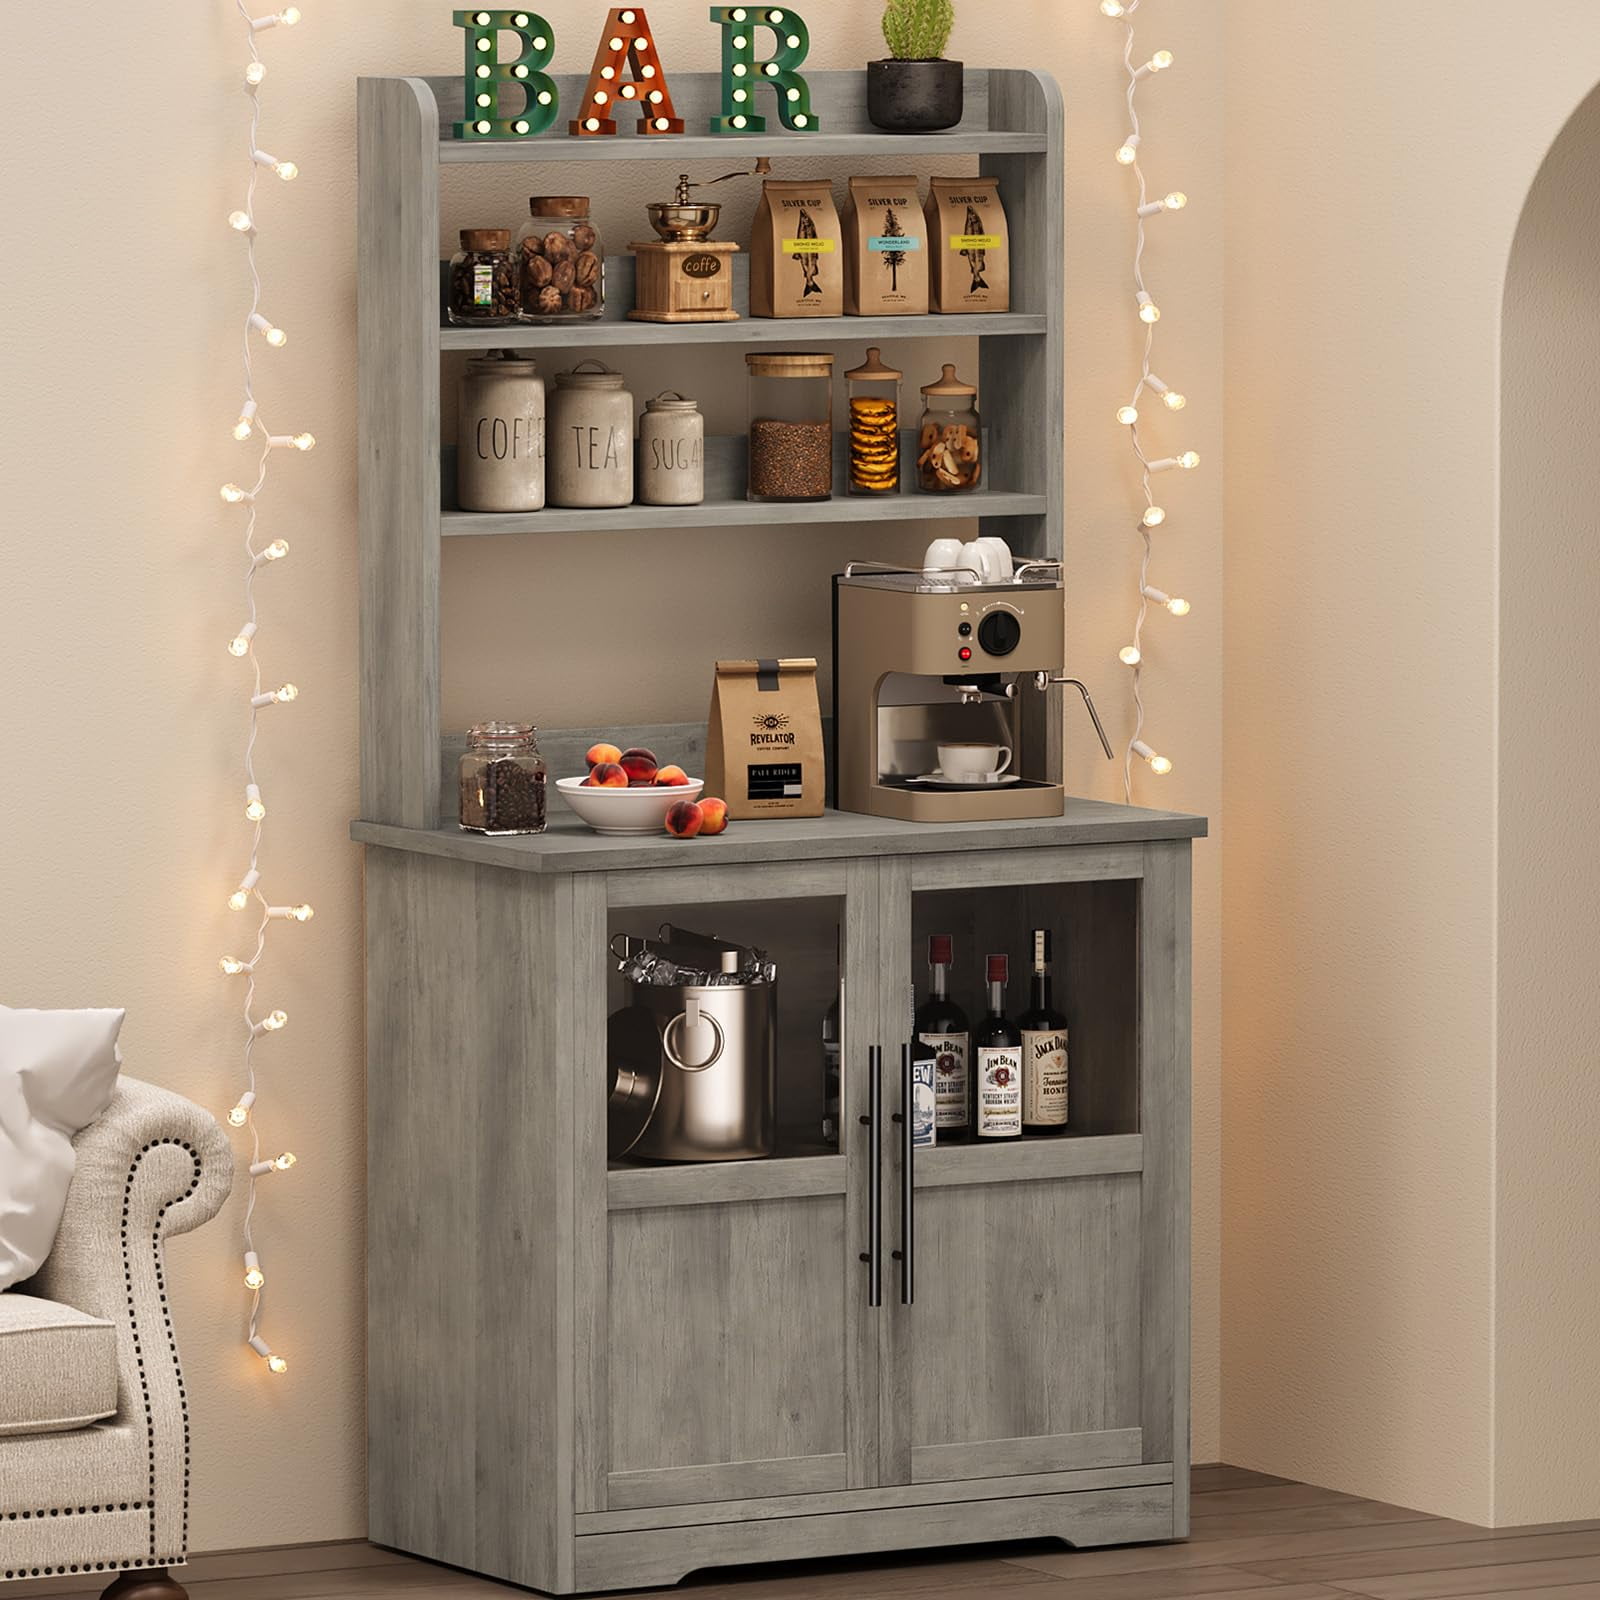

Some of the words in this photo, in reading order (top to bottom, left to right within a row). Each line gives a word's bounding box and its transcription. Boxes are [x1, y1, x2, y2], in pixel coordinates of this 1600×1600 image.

[453, 6, 820, 138] BAR
[781, 199, 805, 208] SILVER
[806, 199, 822, 207] CUP
[868, 198, 892, 206] SILVER
[892, 198, 908, 206] CUP
[949, 196, 972, 204] SILVER
[973, 195, 988, 203] CUP
[685, 256, 717, 272] coffe
[571, 426, 618, 470] TEA
[750, 732, 795, 746] REVELATOR
[1035, 1041, 1055, 1060] JACK
[985, 1057, 999, 1072] JIM
